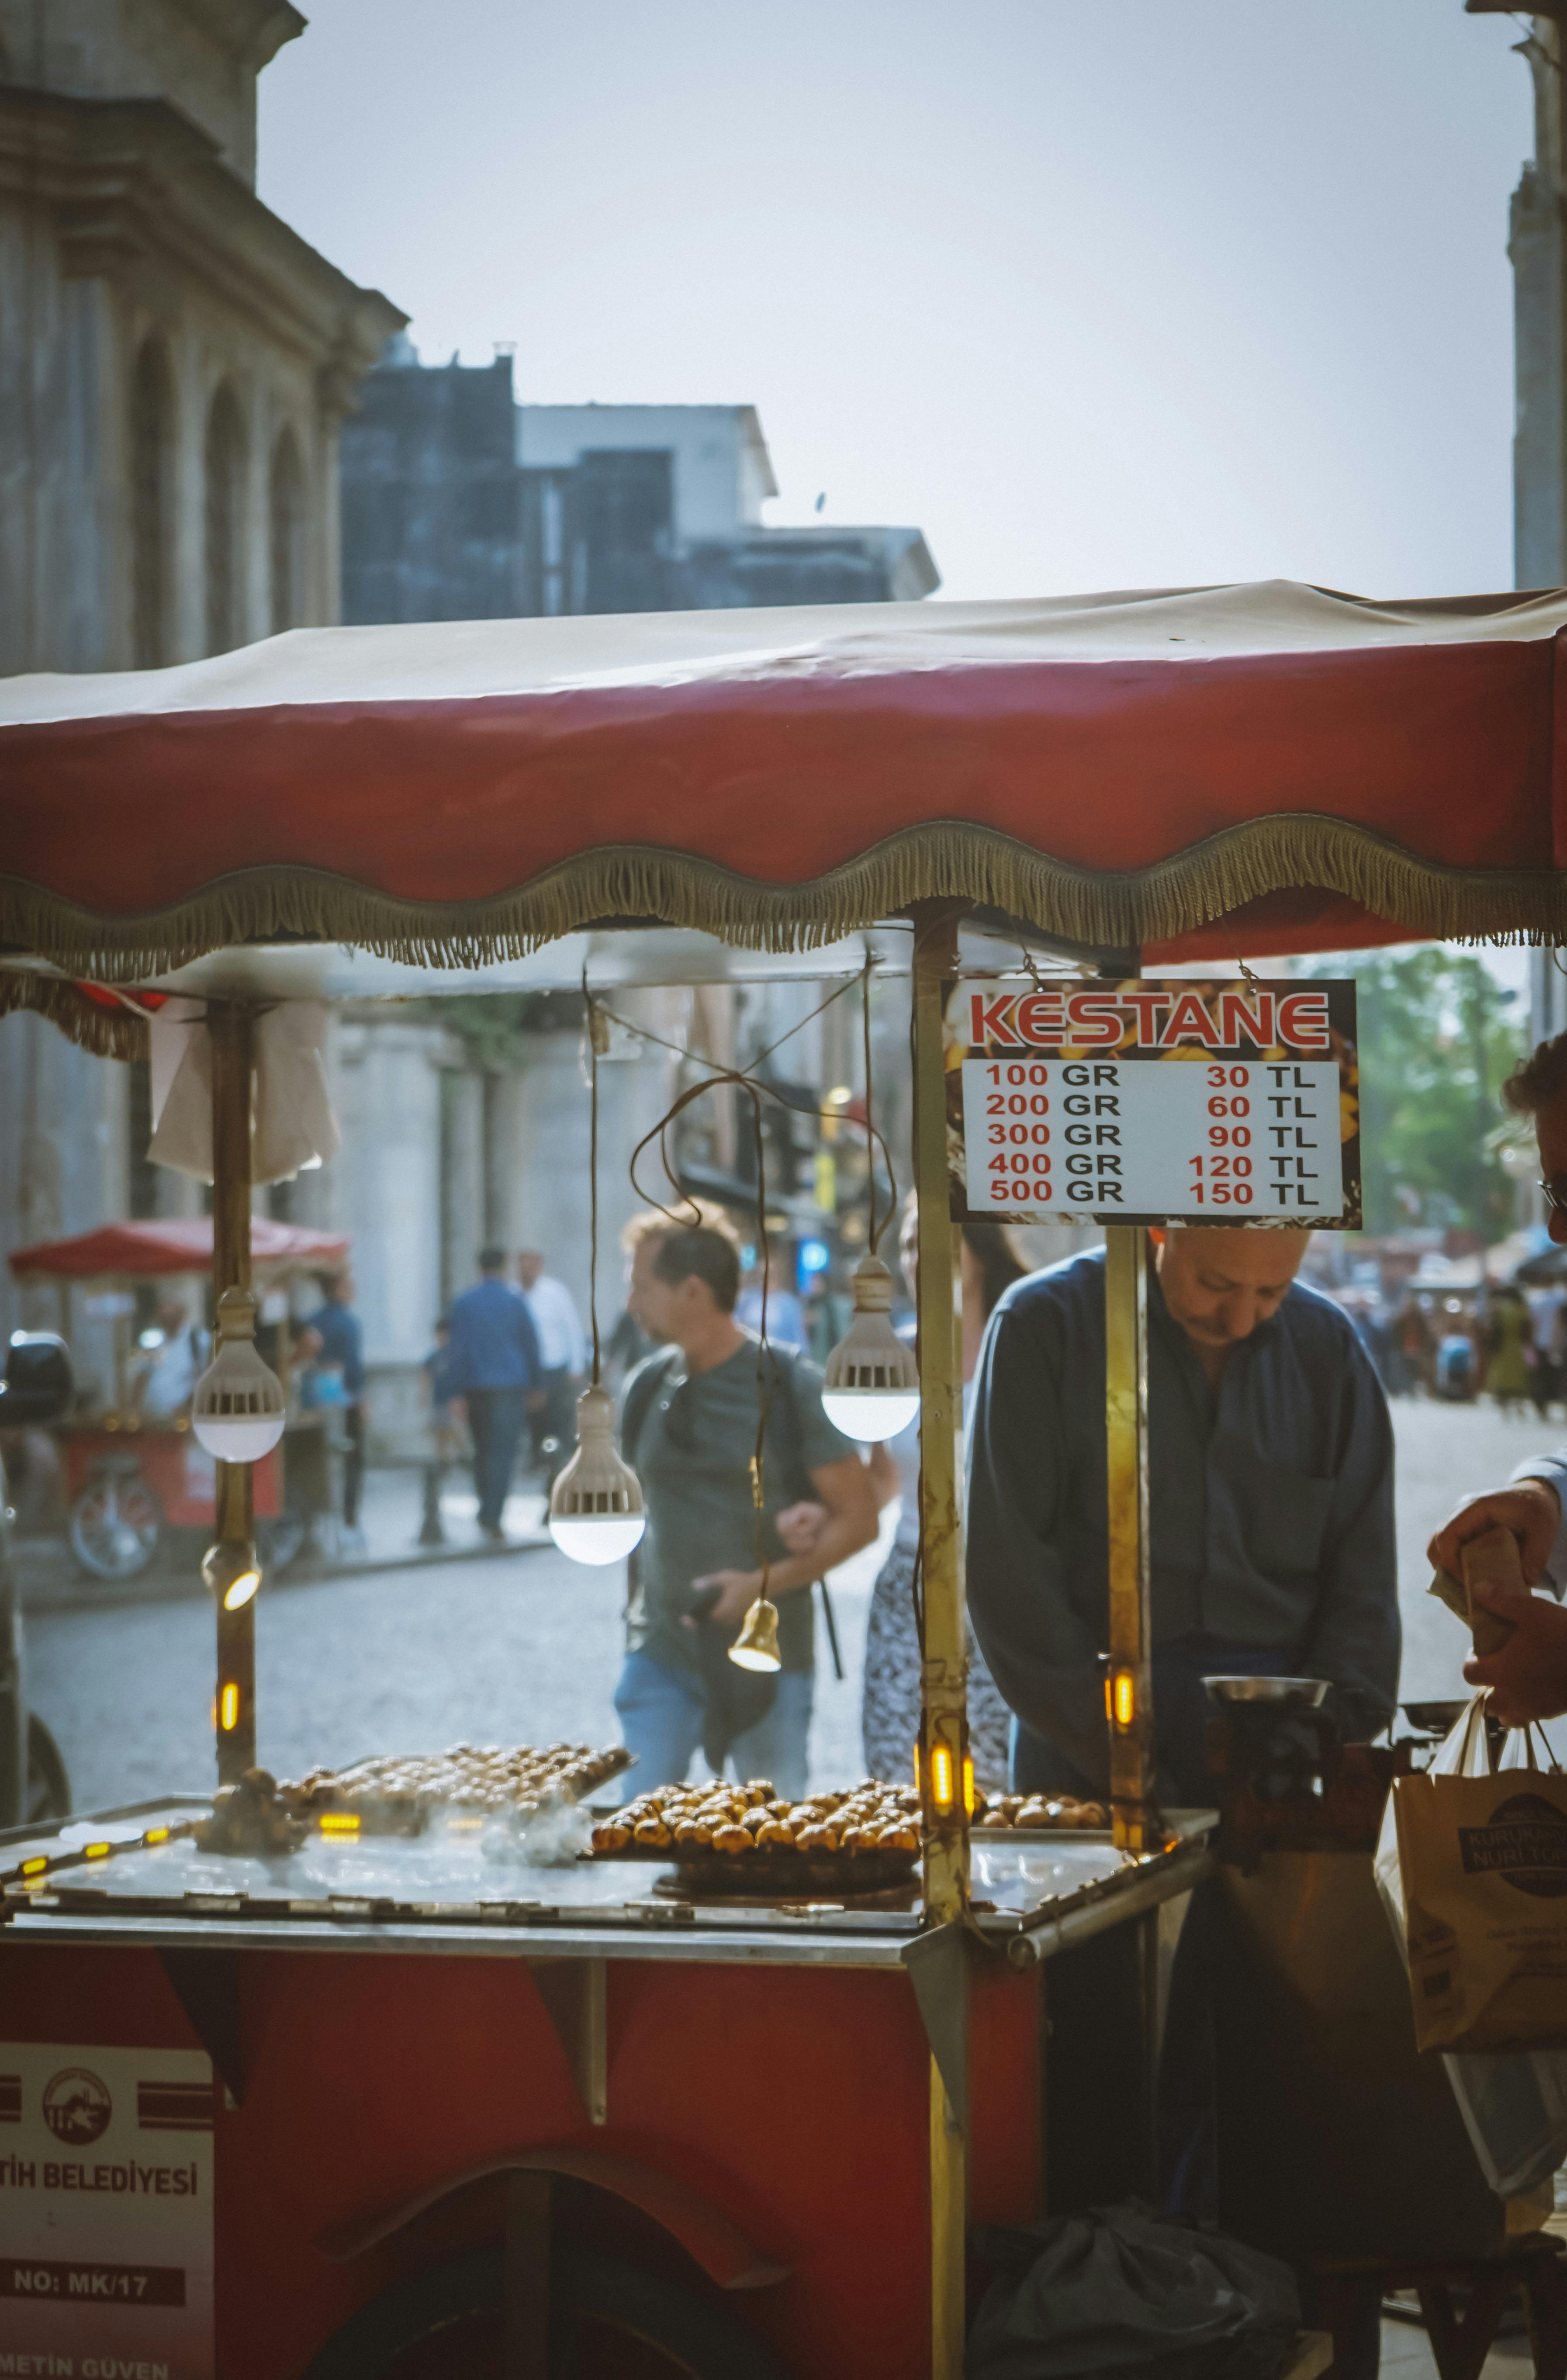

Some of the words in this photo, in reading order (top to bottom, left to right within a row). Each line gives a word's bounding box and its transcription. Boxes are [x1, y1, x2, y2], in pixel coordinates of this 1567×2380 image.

[970, 992, 1329, 1048] KESTANE
[986, 1065, 1048, 1086] 100
[1062, 1065, 1119, 1086] GR
[1207, 1065, 1249, 1088] 30
[1267, 1067, 1315, 1088] TL
[987, 1094, 1049, 1116] 200
[1063, 1095, 1121, 1116] GR
[1207, 1096, 1250, 1117] 60
[1268, 1097, 1316, 1117] TL
[988, 1124, 1050, 1145] 300
[1065, 1124, 1122, 1145] GR
[1208, 1126, 1251, 1148] 90
[1269, 1127, 1317, 1148] TL
[988, 1153, 1051, 1175] 400
[1065, 1154, 1123, 1175] GR
[1189, 1155, 1252, 1177] 120
[1270, 1157, 1318, 1178] TL
[990, 1180, 1052, 1201] 500
[1067, 1181, 1124, 1202] GR
[1190, 1183, 1253, 1204] 150
[1270, 1184, 1319, 1205] TL
[43, 2159, 197, 2196] BELEDİYESİ
[14, 2270, 59, 2292] NO:
[69, 2272, 148, 2296] MK/17
[0, 2352, 73, 2377] METİN
[82, 2356, 169, 2380] GÜVEN
